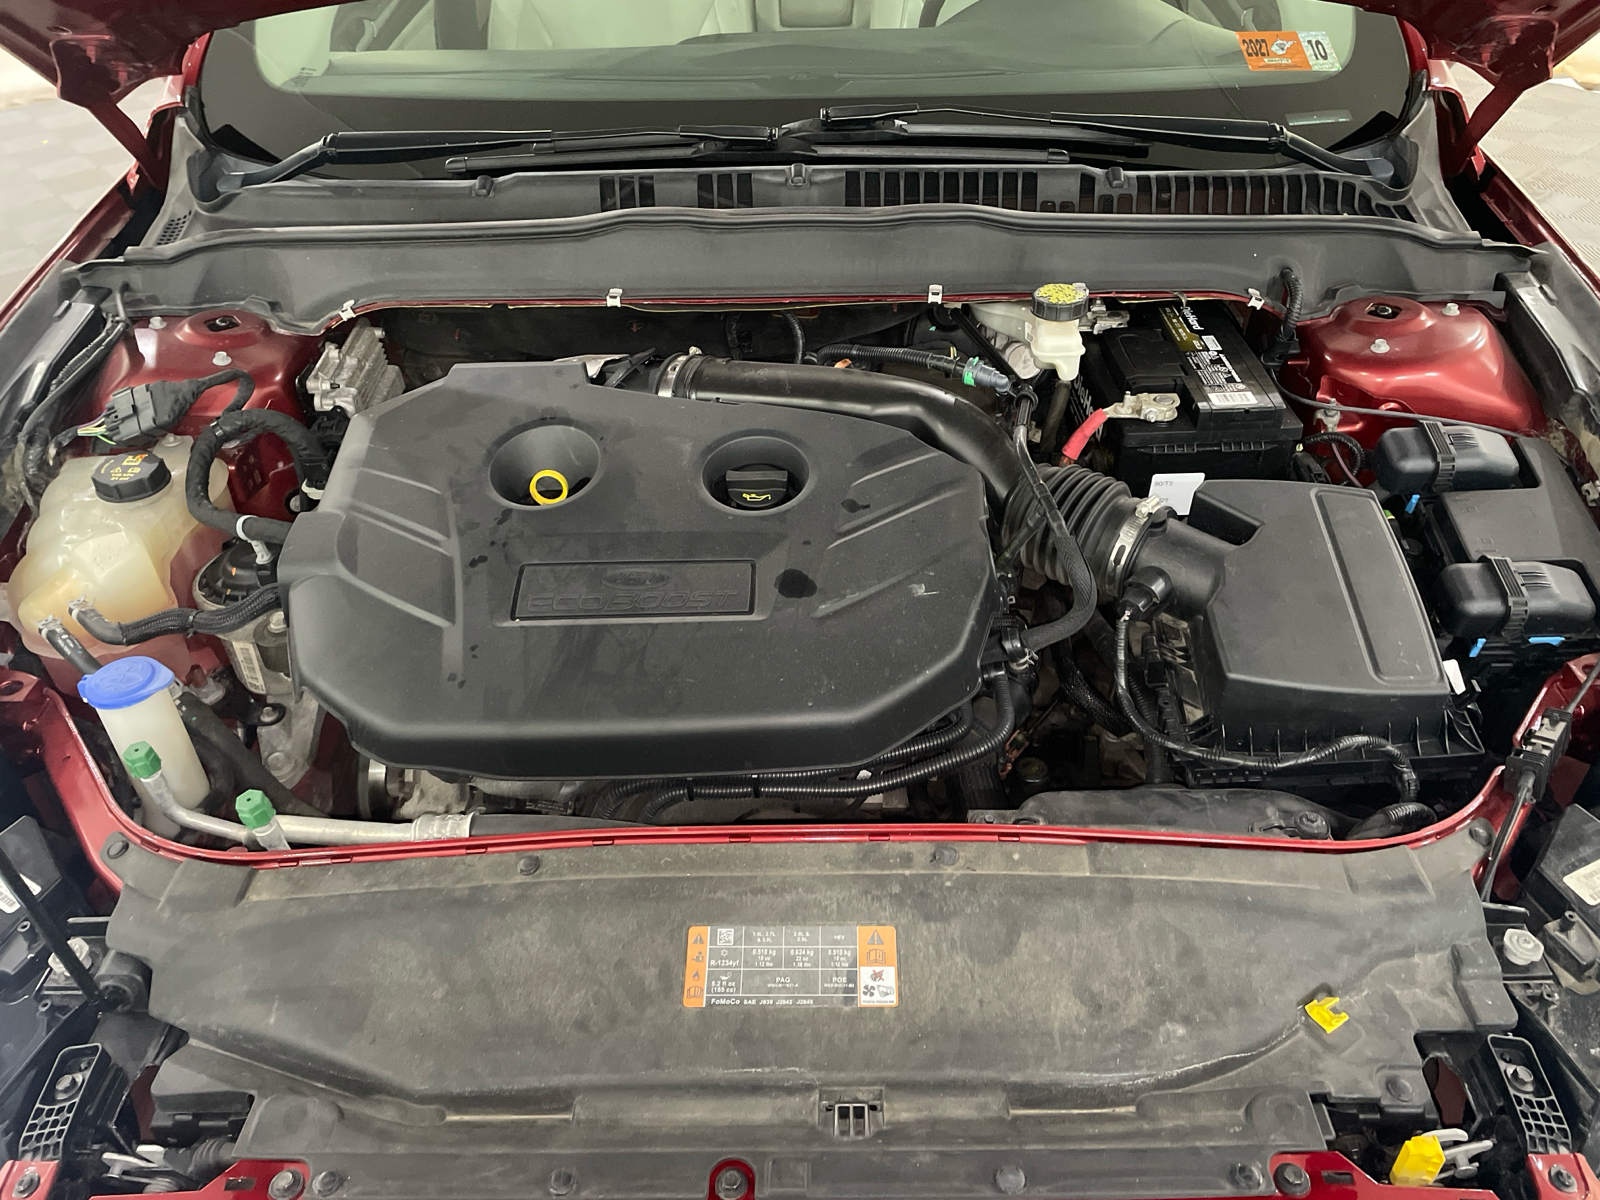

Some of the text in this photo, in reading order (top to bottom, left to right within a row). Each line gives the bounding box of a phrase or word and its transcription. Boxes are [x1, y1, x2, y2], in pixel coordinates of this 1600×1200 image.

[1242, 39, 1270, 57] 2027
[1307, 40, 1328, 60] 10
[1074, 373, 1104, 441] DieHad
[527, 590, 740, 612] ECOBOOST
[710, 958, 739, 967] R-1234yf
[844, 949, 851, 957] kg
